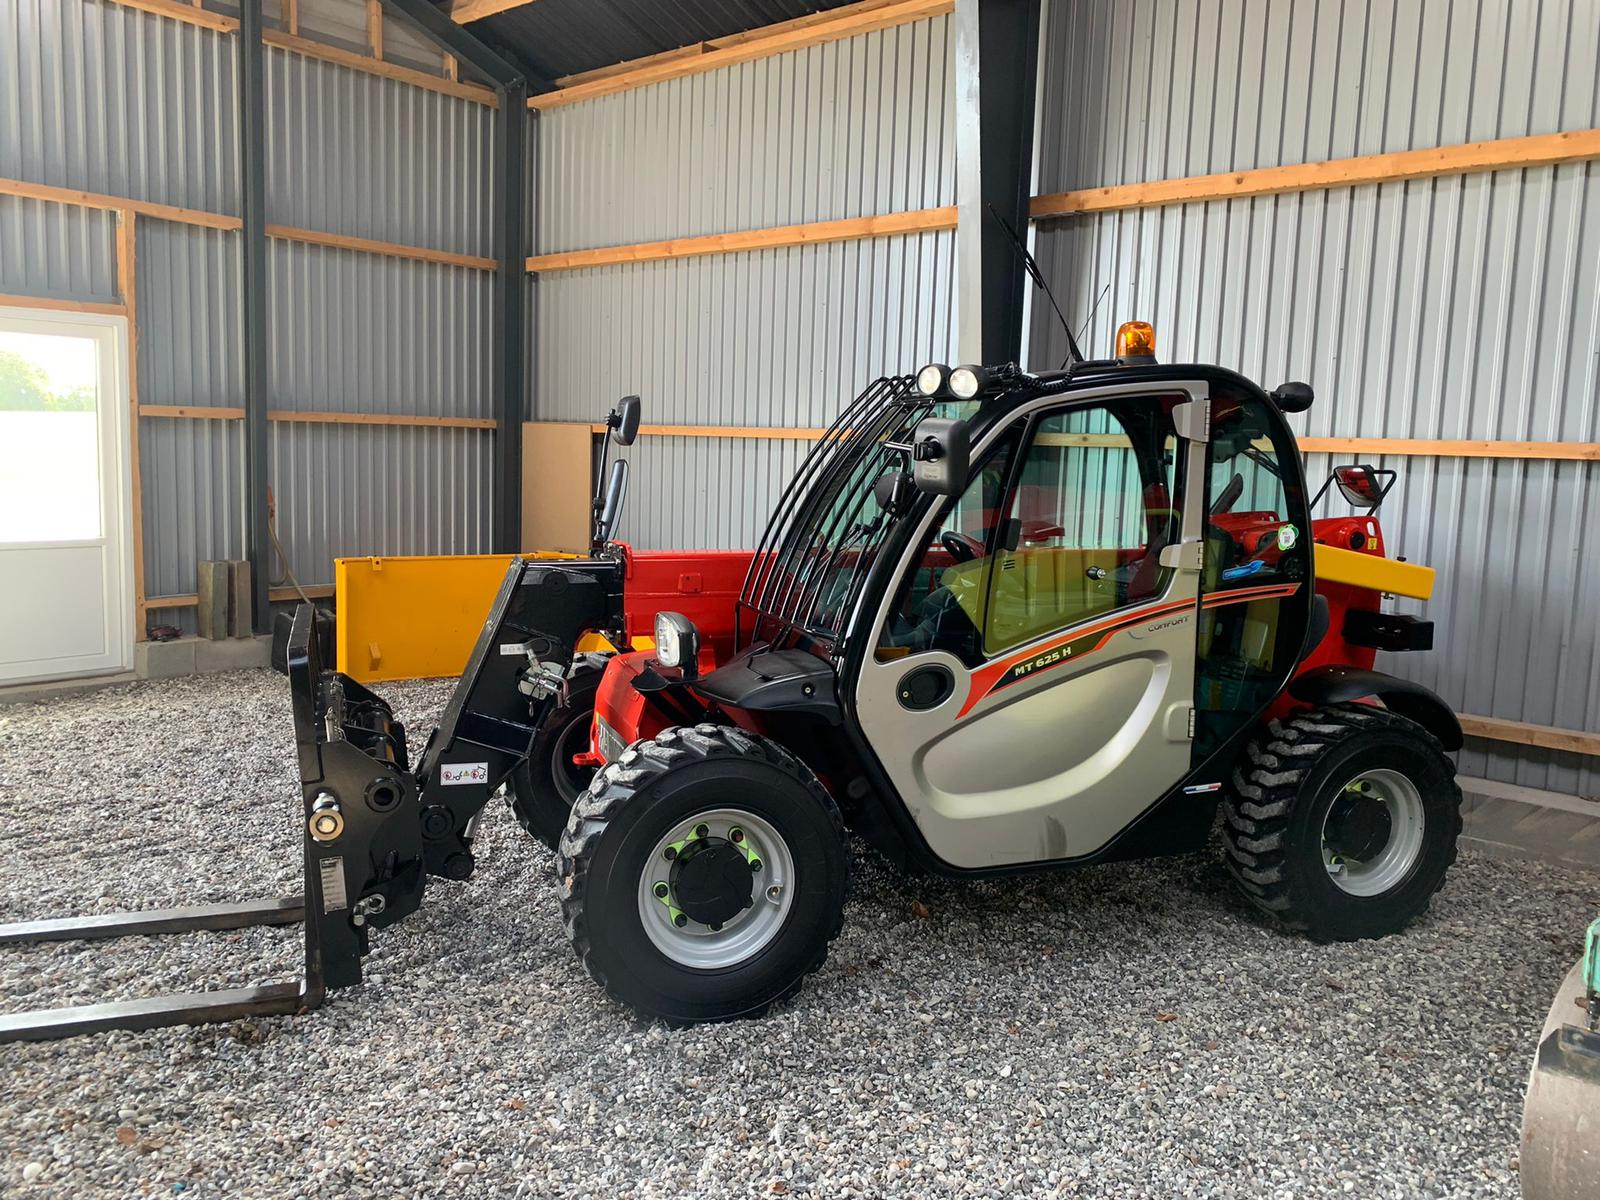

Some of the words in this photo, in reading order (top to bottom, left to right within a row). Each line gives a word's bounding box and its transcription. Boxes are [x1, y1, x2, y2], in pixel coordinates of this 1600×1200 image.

[1014, 662, 1033, 676] MT
[1036, 651, 1060, 667] 625
[1062, 646, 1072, 657] H
